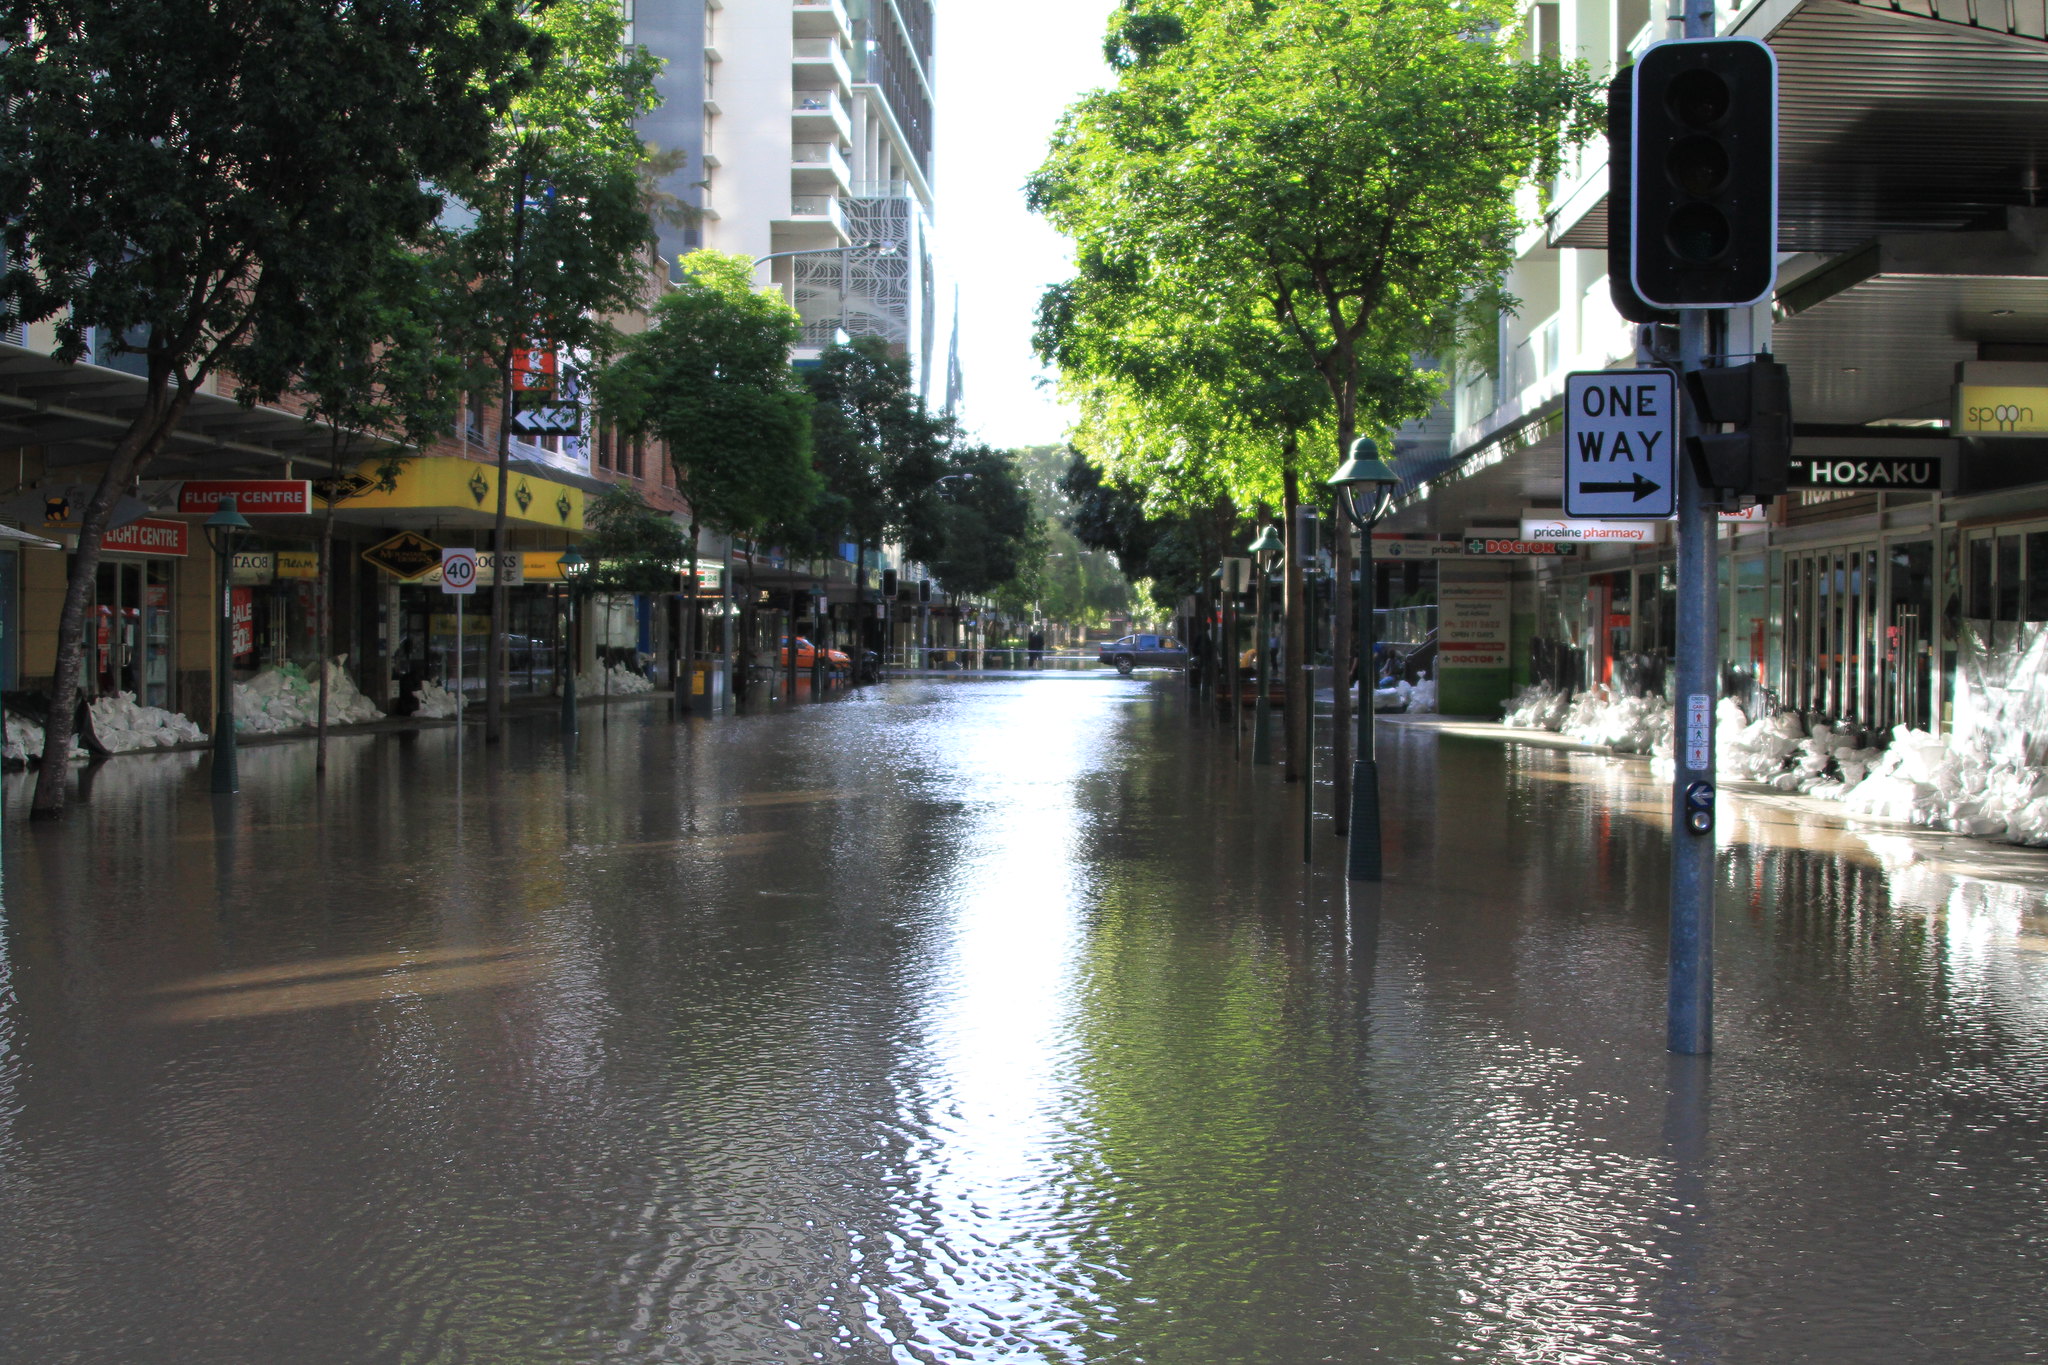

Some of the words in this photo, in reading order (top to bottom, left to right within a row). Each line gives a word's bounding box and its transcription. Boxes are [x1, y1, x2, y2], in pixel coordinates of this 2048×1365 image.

[1583, 385, 1657, 417] ONE
[1968, 404, 2033, 432] spoon
[1577, 431, 1663, 462] WAY
[1811, 461, 1930, 484] HOSAKU
[185, 492, 240, 503] FLIGHT
[242, 492, 303, 503] CENTRE
[105, 525, 139, 544] LIGHT
[140, 527, 179, 547] CENTRE
[1534, 524, 1582, 540] priceline
[1583, 527, 1645, 541] pharmacy
[1432, 544, 1464, 556] pricelin
[1485, 539, 1557, 554] DOCTOR
[446, 562, 471, 579] 40
[475, 556, 517, 570] OOKS
[1452, 655, 1495, 663] DOCTOR
